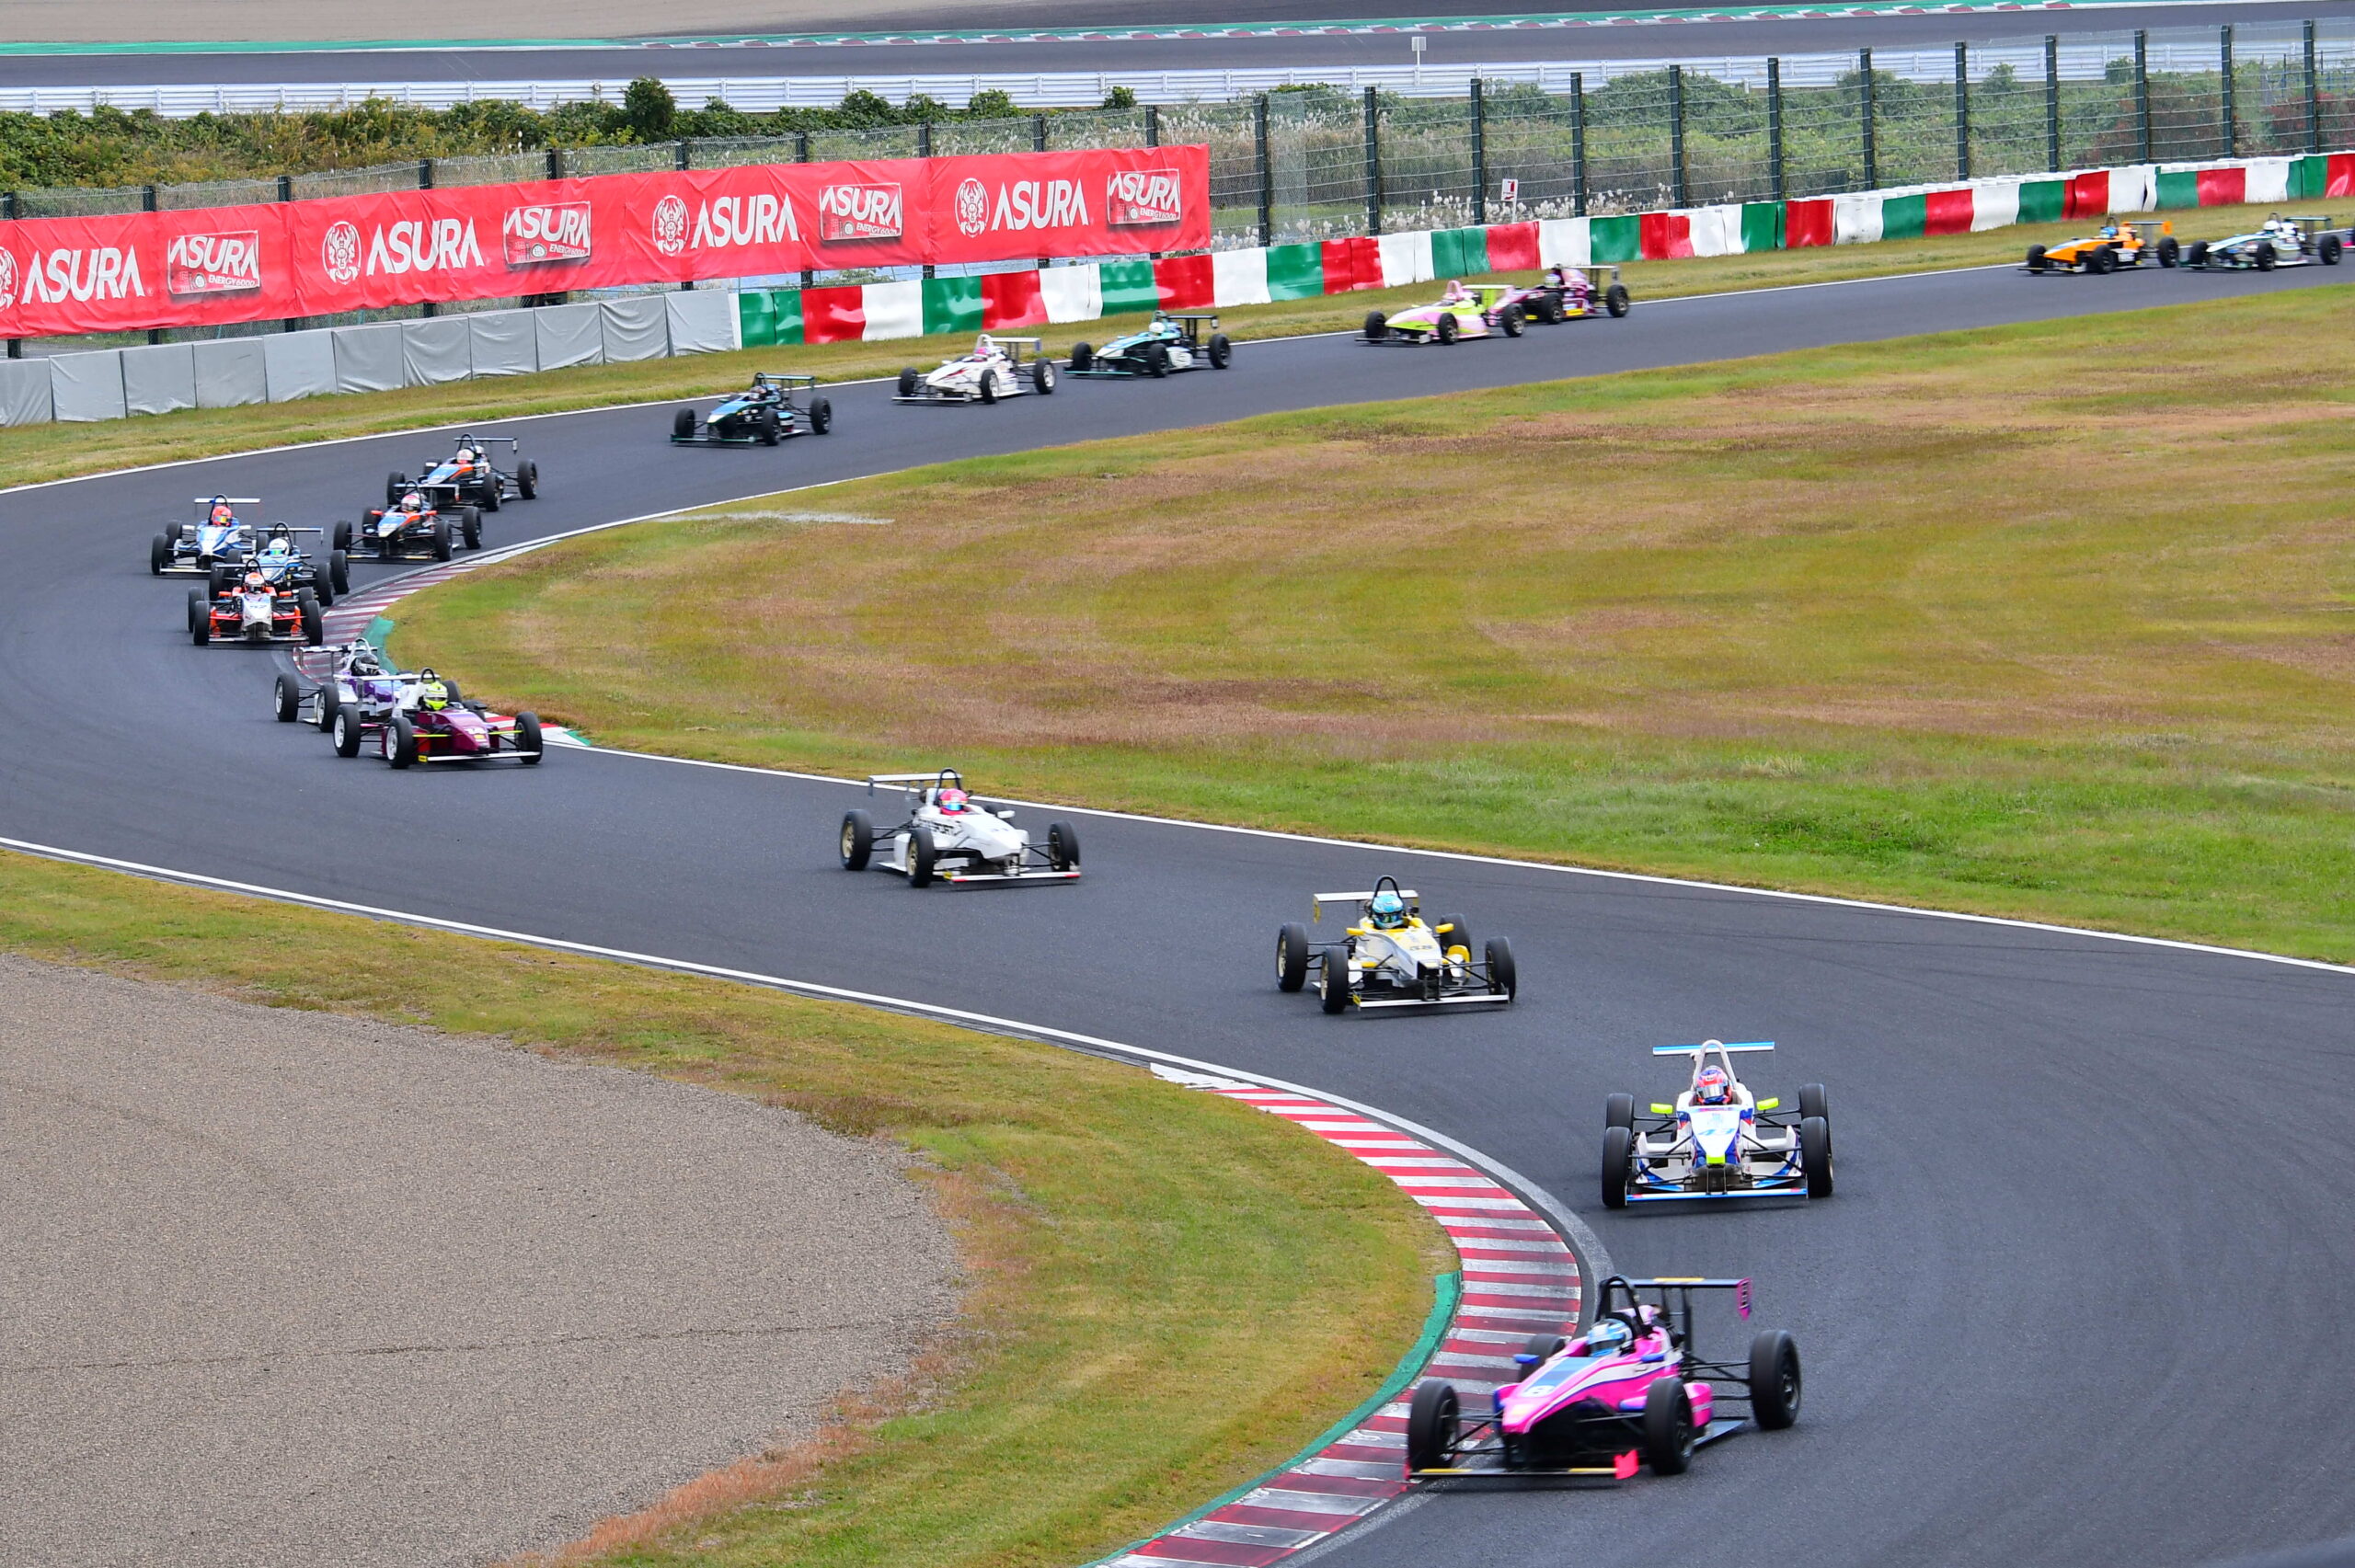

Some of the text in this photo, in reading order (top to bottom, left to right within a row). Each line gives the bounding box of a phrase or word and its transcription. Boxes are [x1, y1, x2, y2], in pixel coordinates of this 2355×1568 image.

[821, 186, 902, 229] ASURA
[991, 177, 1089, 231] ASURA
[1109, 172, 1180, 212] ASURA
[504, 208, 590, 248] ASURA
[690, 192, 799, 249] ASURA
[169, 235, 258, 280] ASURA
[366, 216, 485, 276] ASURA
[21, 244, 145, 304] ASURA
